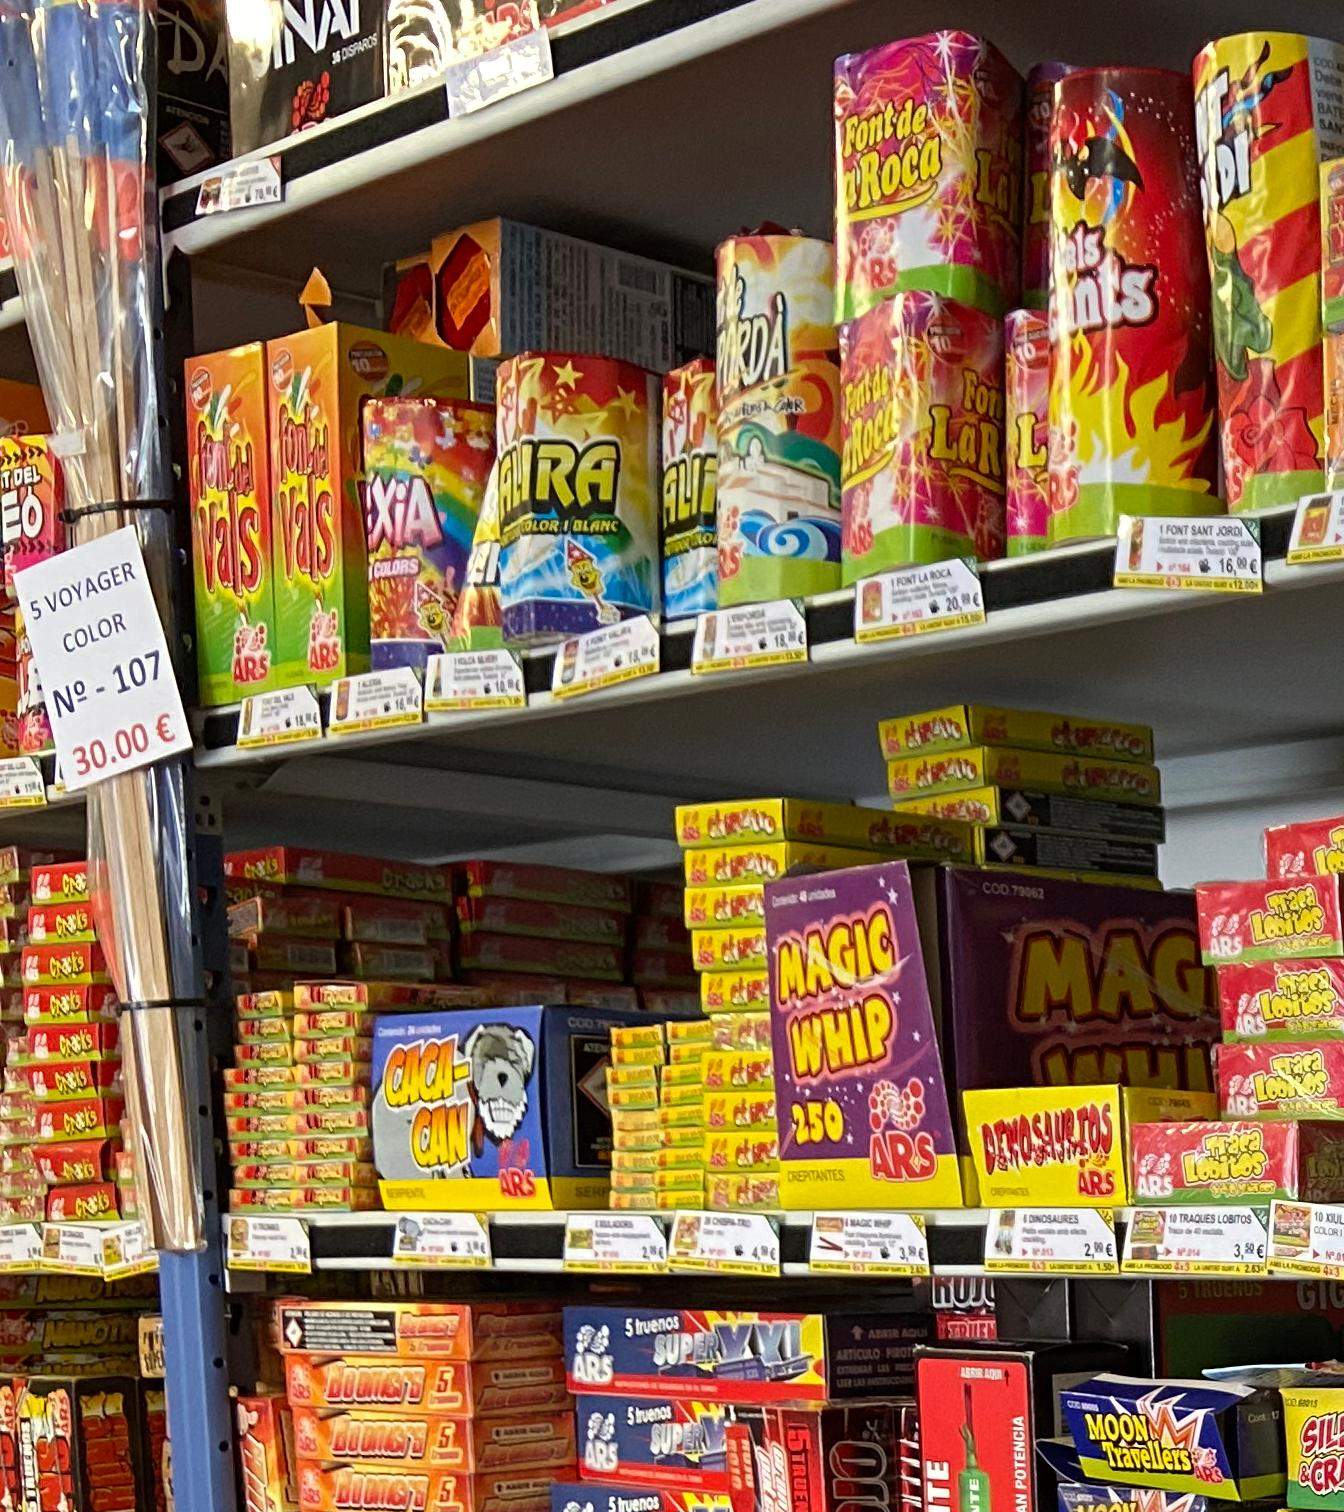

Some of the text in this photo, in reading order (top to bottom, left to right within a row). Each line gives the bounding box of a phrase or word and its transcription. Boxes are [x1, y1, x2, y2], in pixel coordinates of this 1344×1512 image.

[341, 33, 378, 61] DISPAROS
[860, 134, 942, 196] Roca
[1166, 525, 1189, 536] FONT
[1192, 525, 1214, 536] SANT
[1216, 525, 1243, 537] JORDI
[29, 561, 137, 621] 5 VOYAGER
[62, 612, 128, 653] COLOR
[52, 650, 163, 718] Nº 107
[72, 713, 176, 775] 30.00 €
[776, 909, 896, 1006] MAGIC
[791, 996, 893, 1079] WHIP
[384, 1037, 473, 1107] CACA-
[411, 1106, 472, 1169] CAN
[792, 1097, 843, 1145] 250
[869, 1130, 938, 1181] ARS
[1169, 1214, 1252, 1225] 10 TRAQUES LOBITOS
[1012, 1416, 1027, 1485] POTENCIA
[1086, 1413, 1147, 1444] MOON
[1102, 1442, 1191, 1474] Travellers
